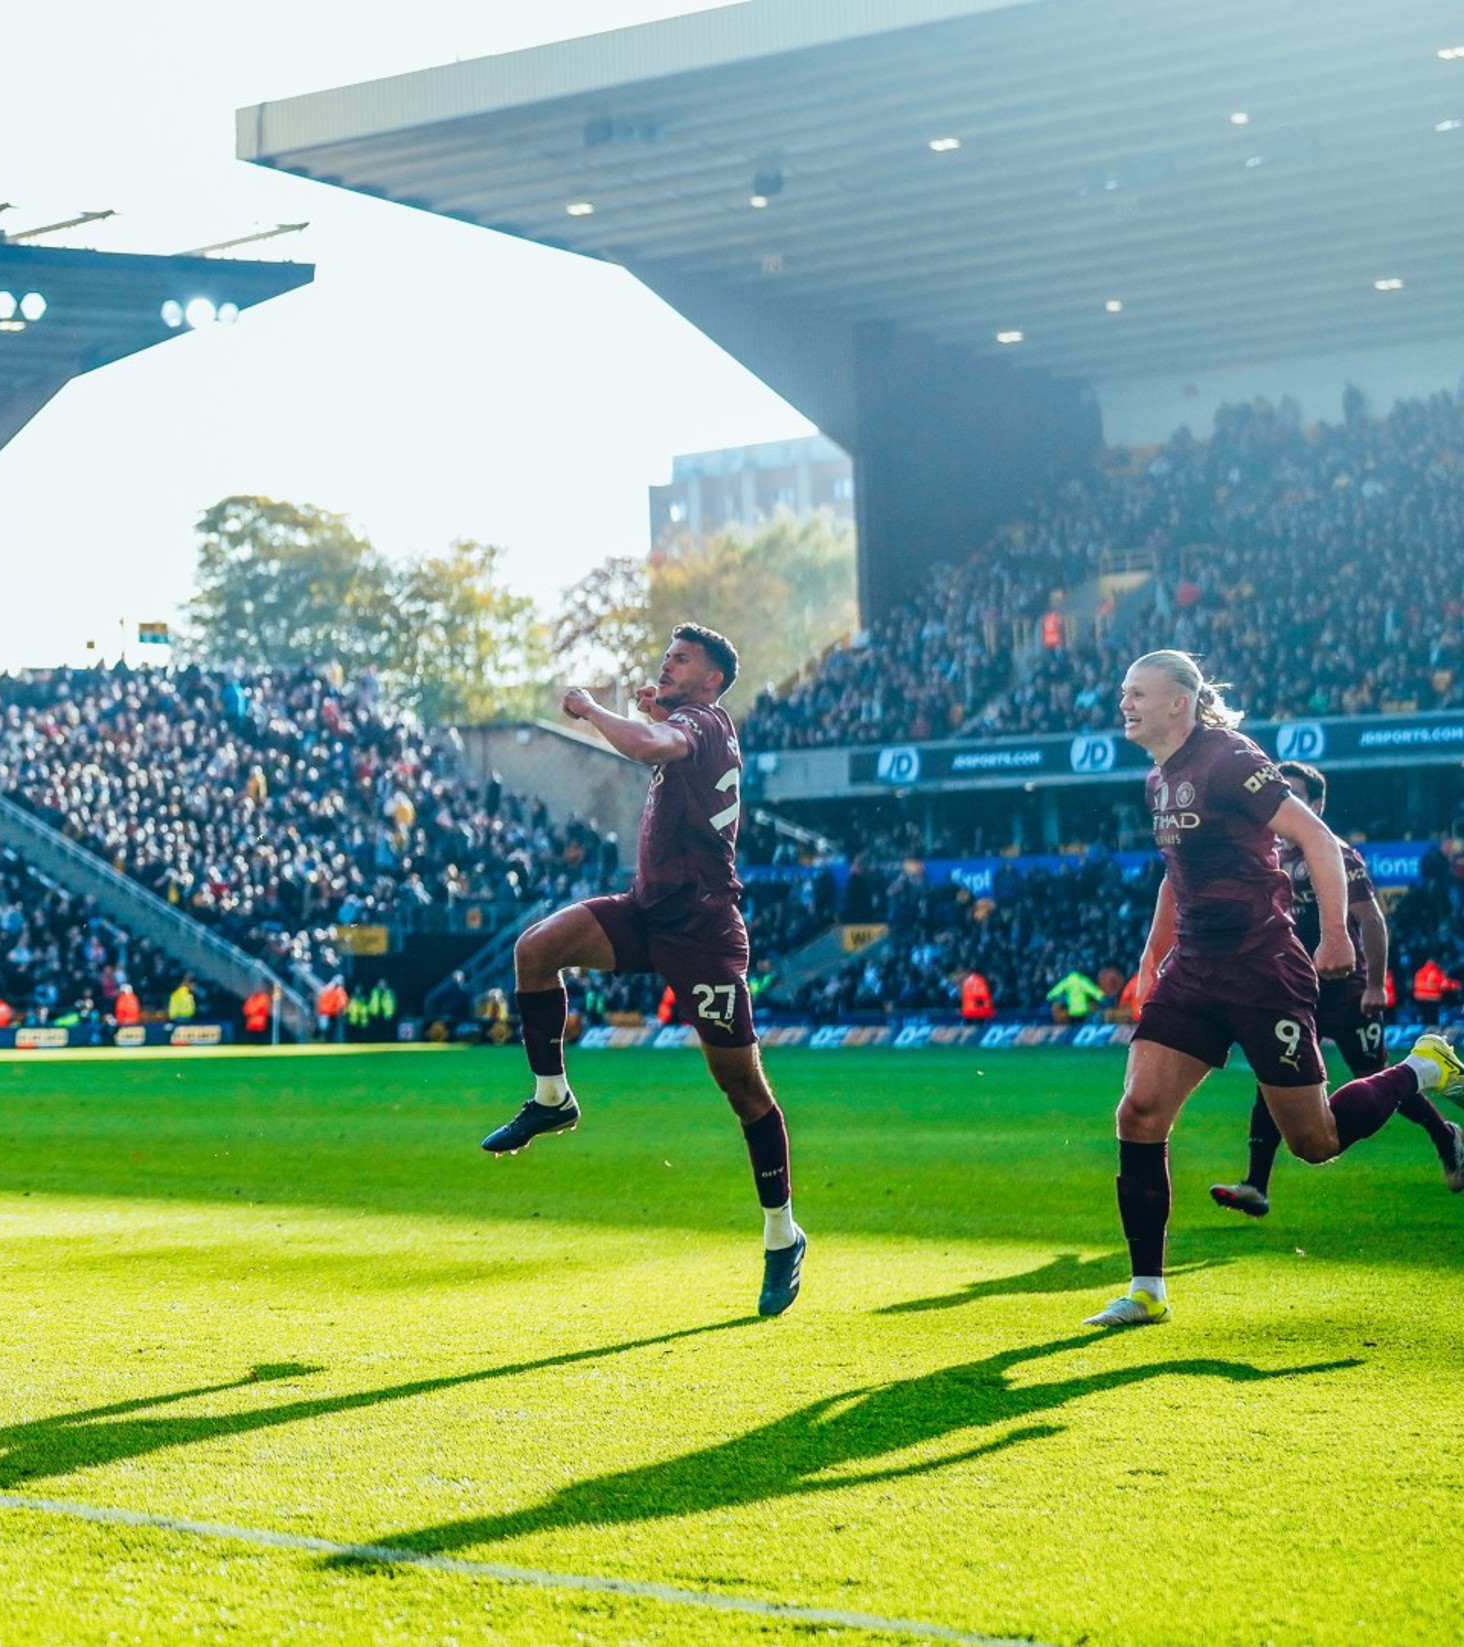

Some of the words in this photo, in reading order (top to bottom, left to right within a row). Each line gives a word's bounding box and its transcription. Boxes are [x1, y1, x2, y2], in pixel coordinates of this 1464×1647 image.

[884, 751, 916, 779] JD
[1075, 740, 1110, 767] JD
[1283, 725, 1320, 757] JD
[691, 983, 736, 1020] 27
[1274, 1019, 1301, 1056] 9
[1355, 1022, 1382, 1053] 19
